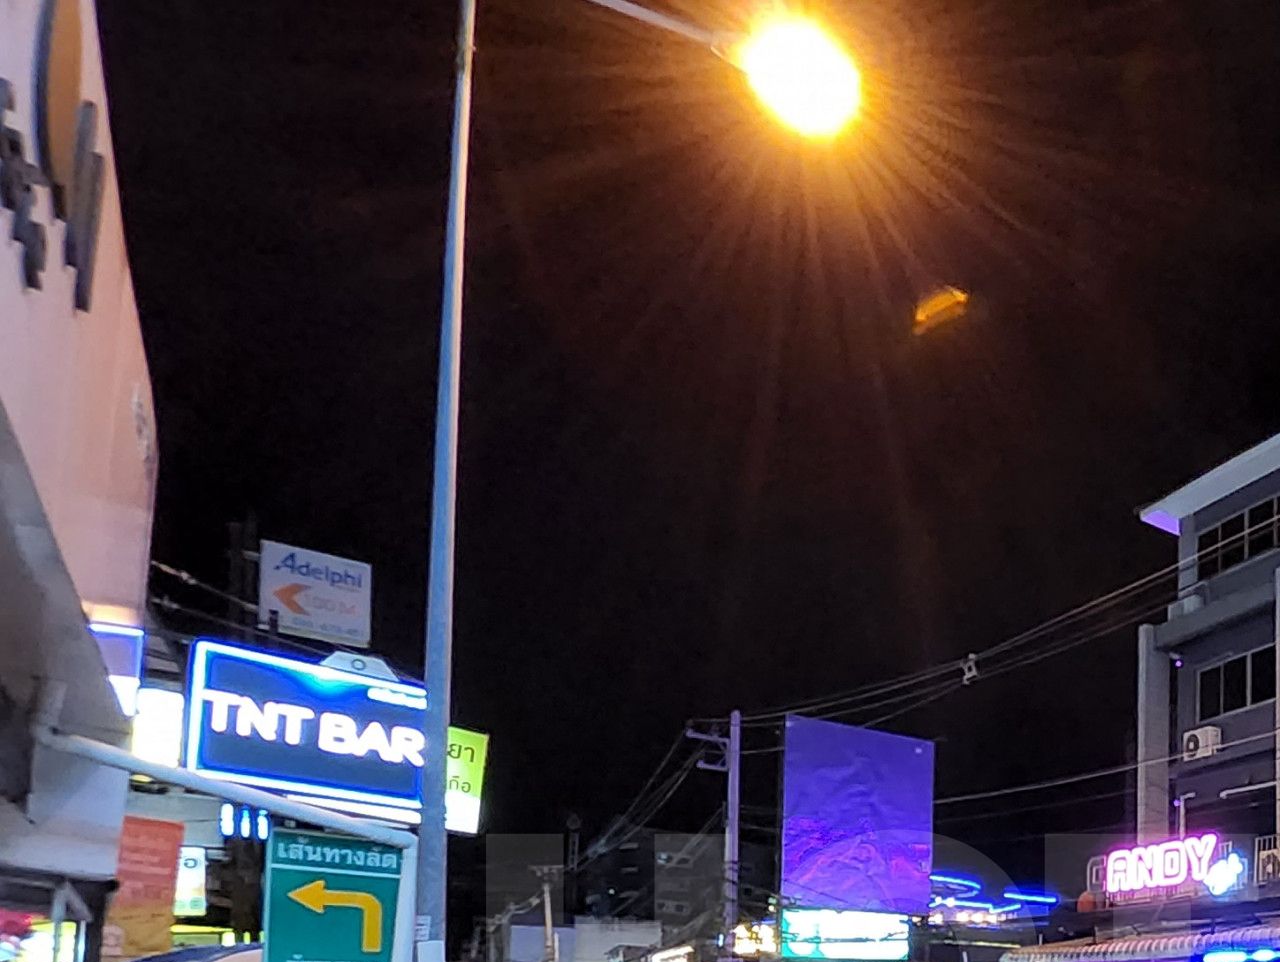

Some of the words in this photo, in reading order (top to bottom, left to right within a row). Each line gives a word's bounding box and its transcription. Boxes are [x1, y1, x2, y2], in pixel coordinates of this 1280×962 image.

[273, 552, 362, 588] Adelphi
[203, 688, 315, 747] TNT
[317, 712, 425, 767] BAR
